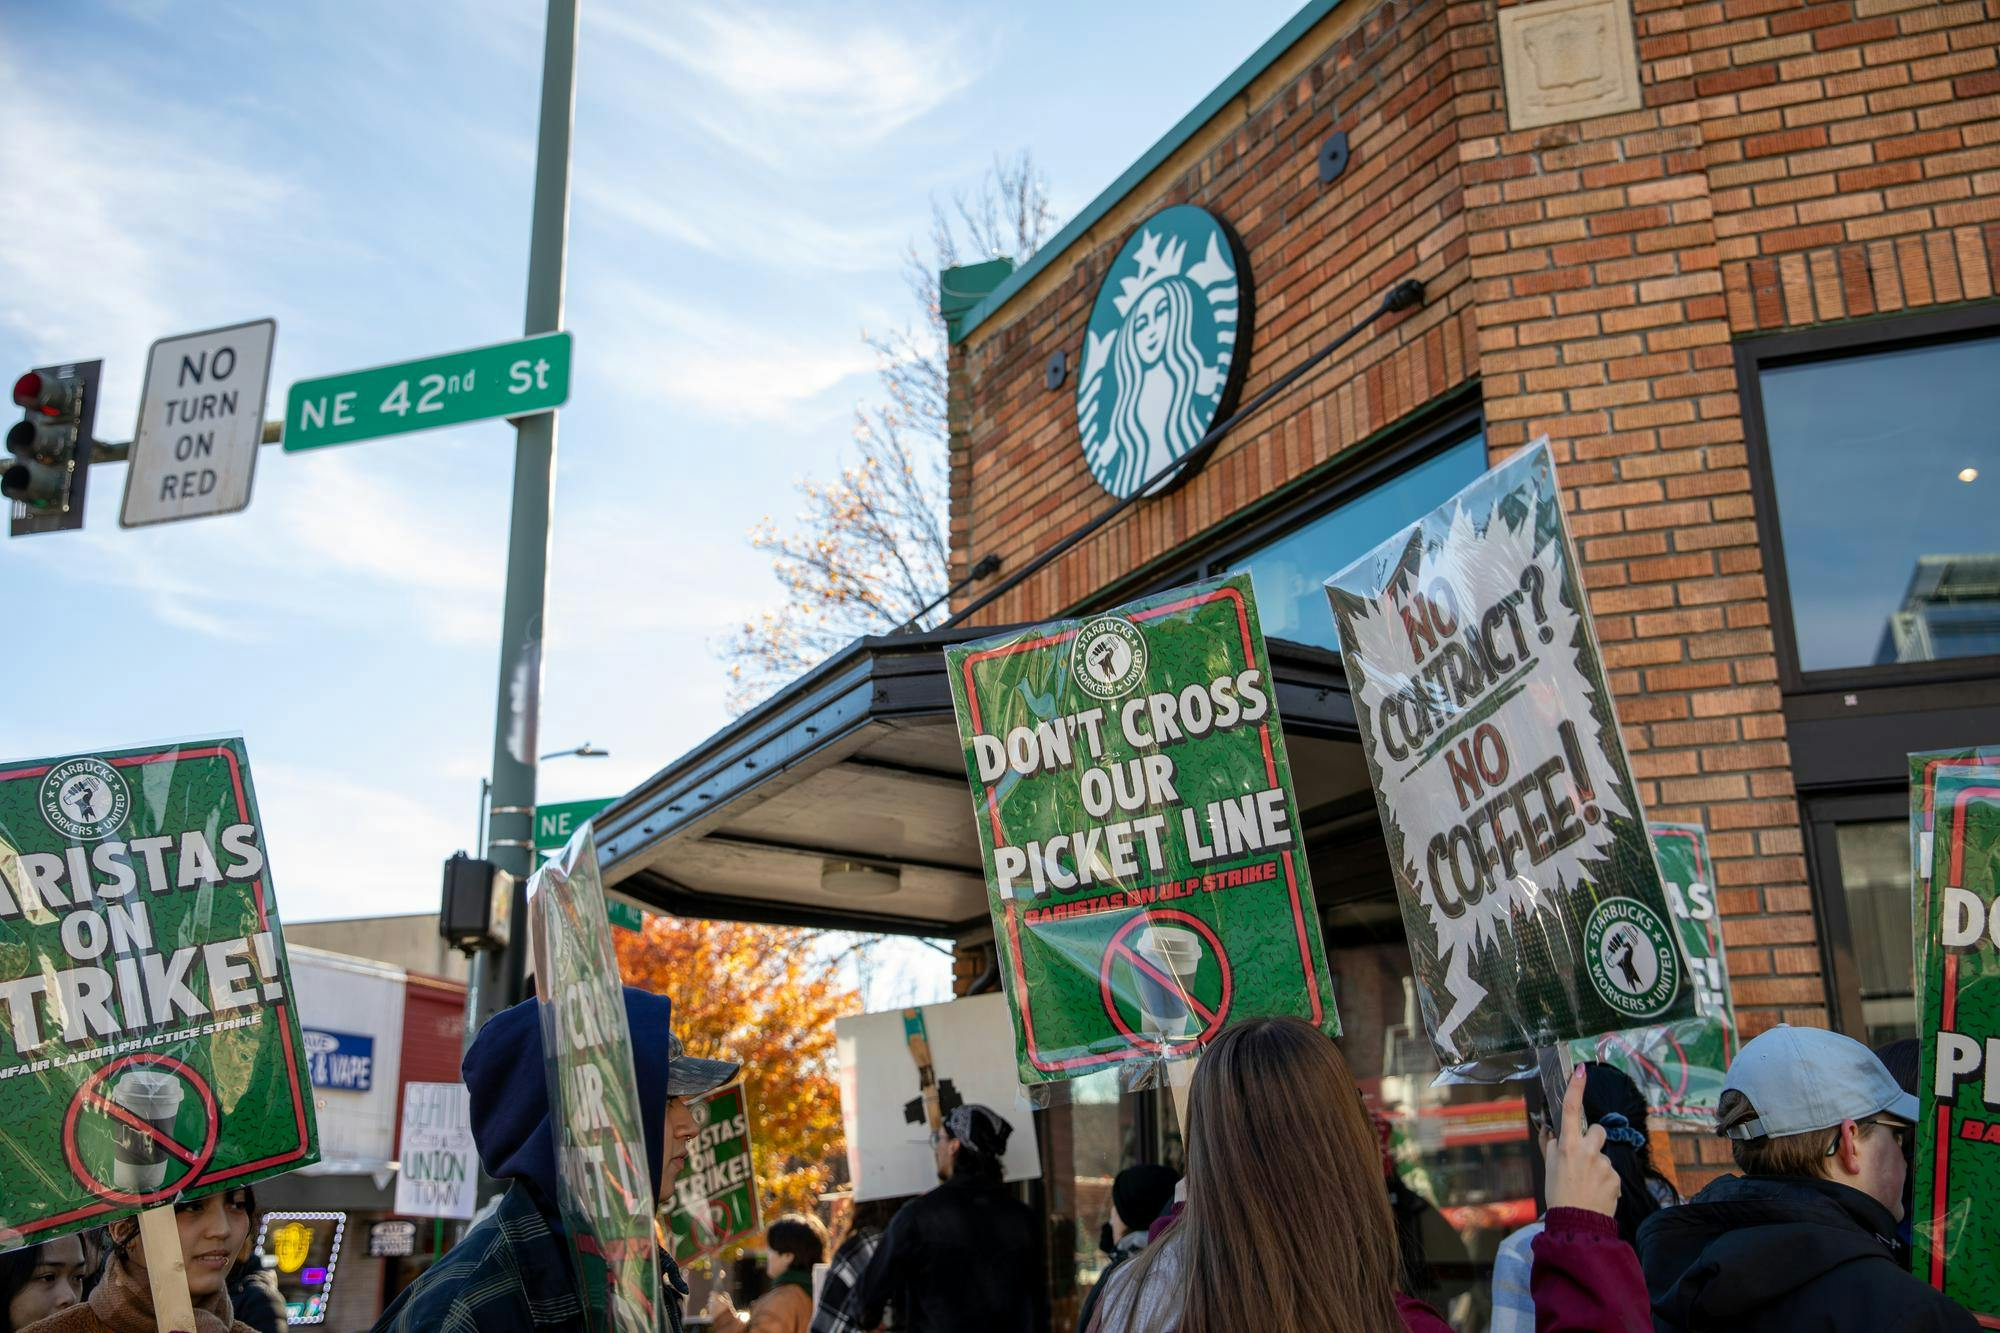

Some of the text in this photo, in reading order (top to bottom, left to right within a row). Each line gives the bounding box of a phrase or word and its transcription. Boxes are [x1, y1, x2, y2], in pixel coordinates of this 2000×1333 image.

[178, 346, 236, 388] NO
[165, 390, 239, 426] TURN
[299, 358, 550, 432] NE 42nd St
[174, 431, 214, 463] ON
[160, 468, 217, 501] RED
[1078, 621, 1133, 650] STARBUCKS
[1400, 576, 1459, 665] NO
[1076, 649, 1143, 695] WORKERS UNITED
[1379, 564, 1555, 762] CONTRACT?
[973, 669, 1268, 784] DON'T CROSS
[50, 762, 115, 788] STARBUCKS
[1080, 754, 1178, 818] OUR
[1444, 723, 1509, 812] NO
[46, 793, 125, 836] WORKERS UNITED
[541, 812, 572, 838] NE
[1427, 719, 1601, 920] COFFEE!
[994, 788, 1293, 900] PICKET LINE
[1025, 892, 1127, 922] BARISTAS
[1159, 878, 1199, 901] ULP
[1202, 862, 1277, 892] STRIKE
[61, 901, 153, 960] ON
[1590, 903, 1654, 943] STARBUCKS
[1592, 947, 1673, 1011] WORKERS UNITED
[53, 1043, 115, 1066] LABOR
[118, 1026, 200, 1052] PRACTICE
[202, 1013, 262, 1034] STRIKE
[329, 1053, 371, 1090] VAPE
[402, 1150, 467, 1182] UNION
